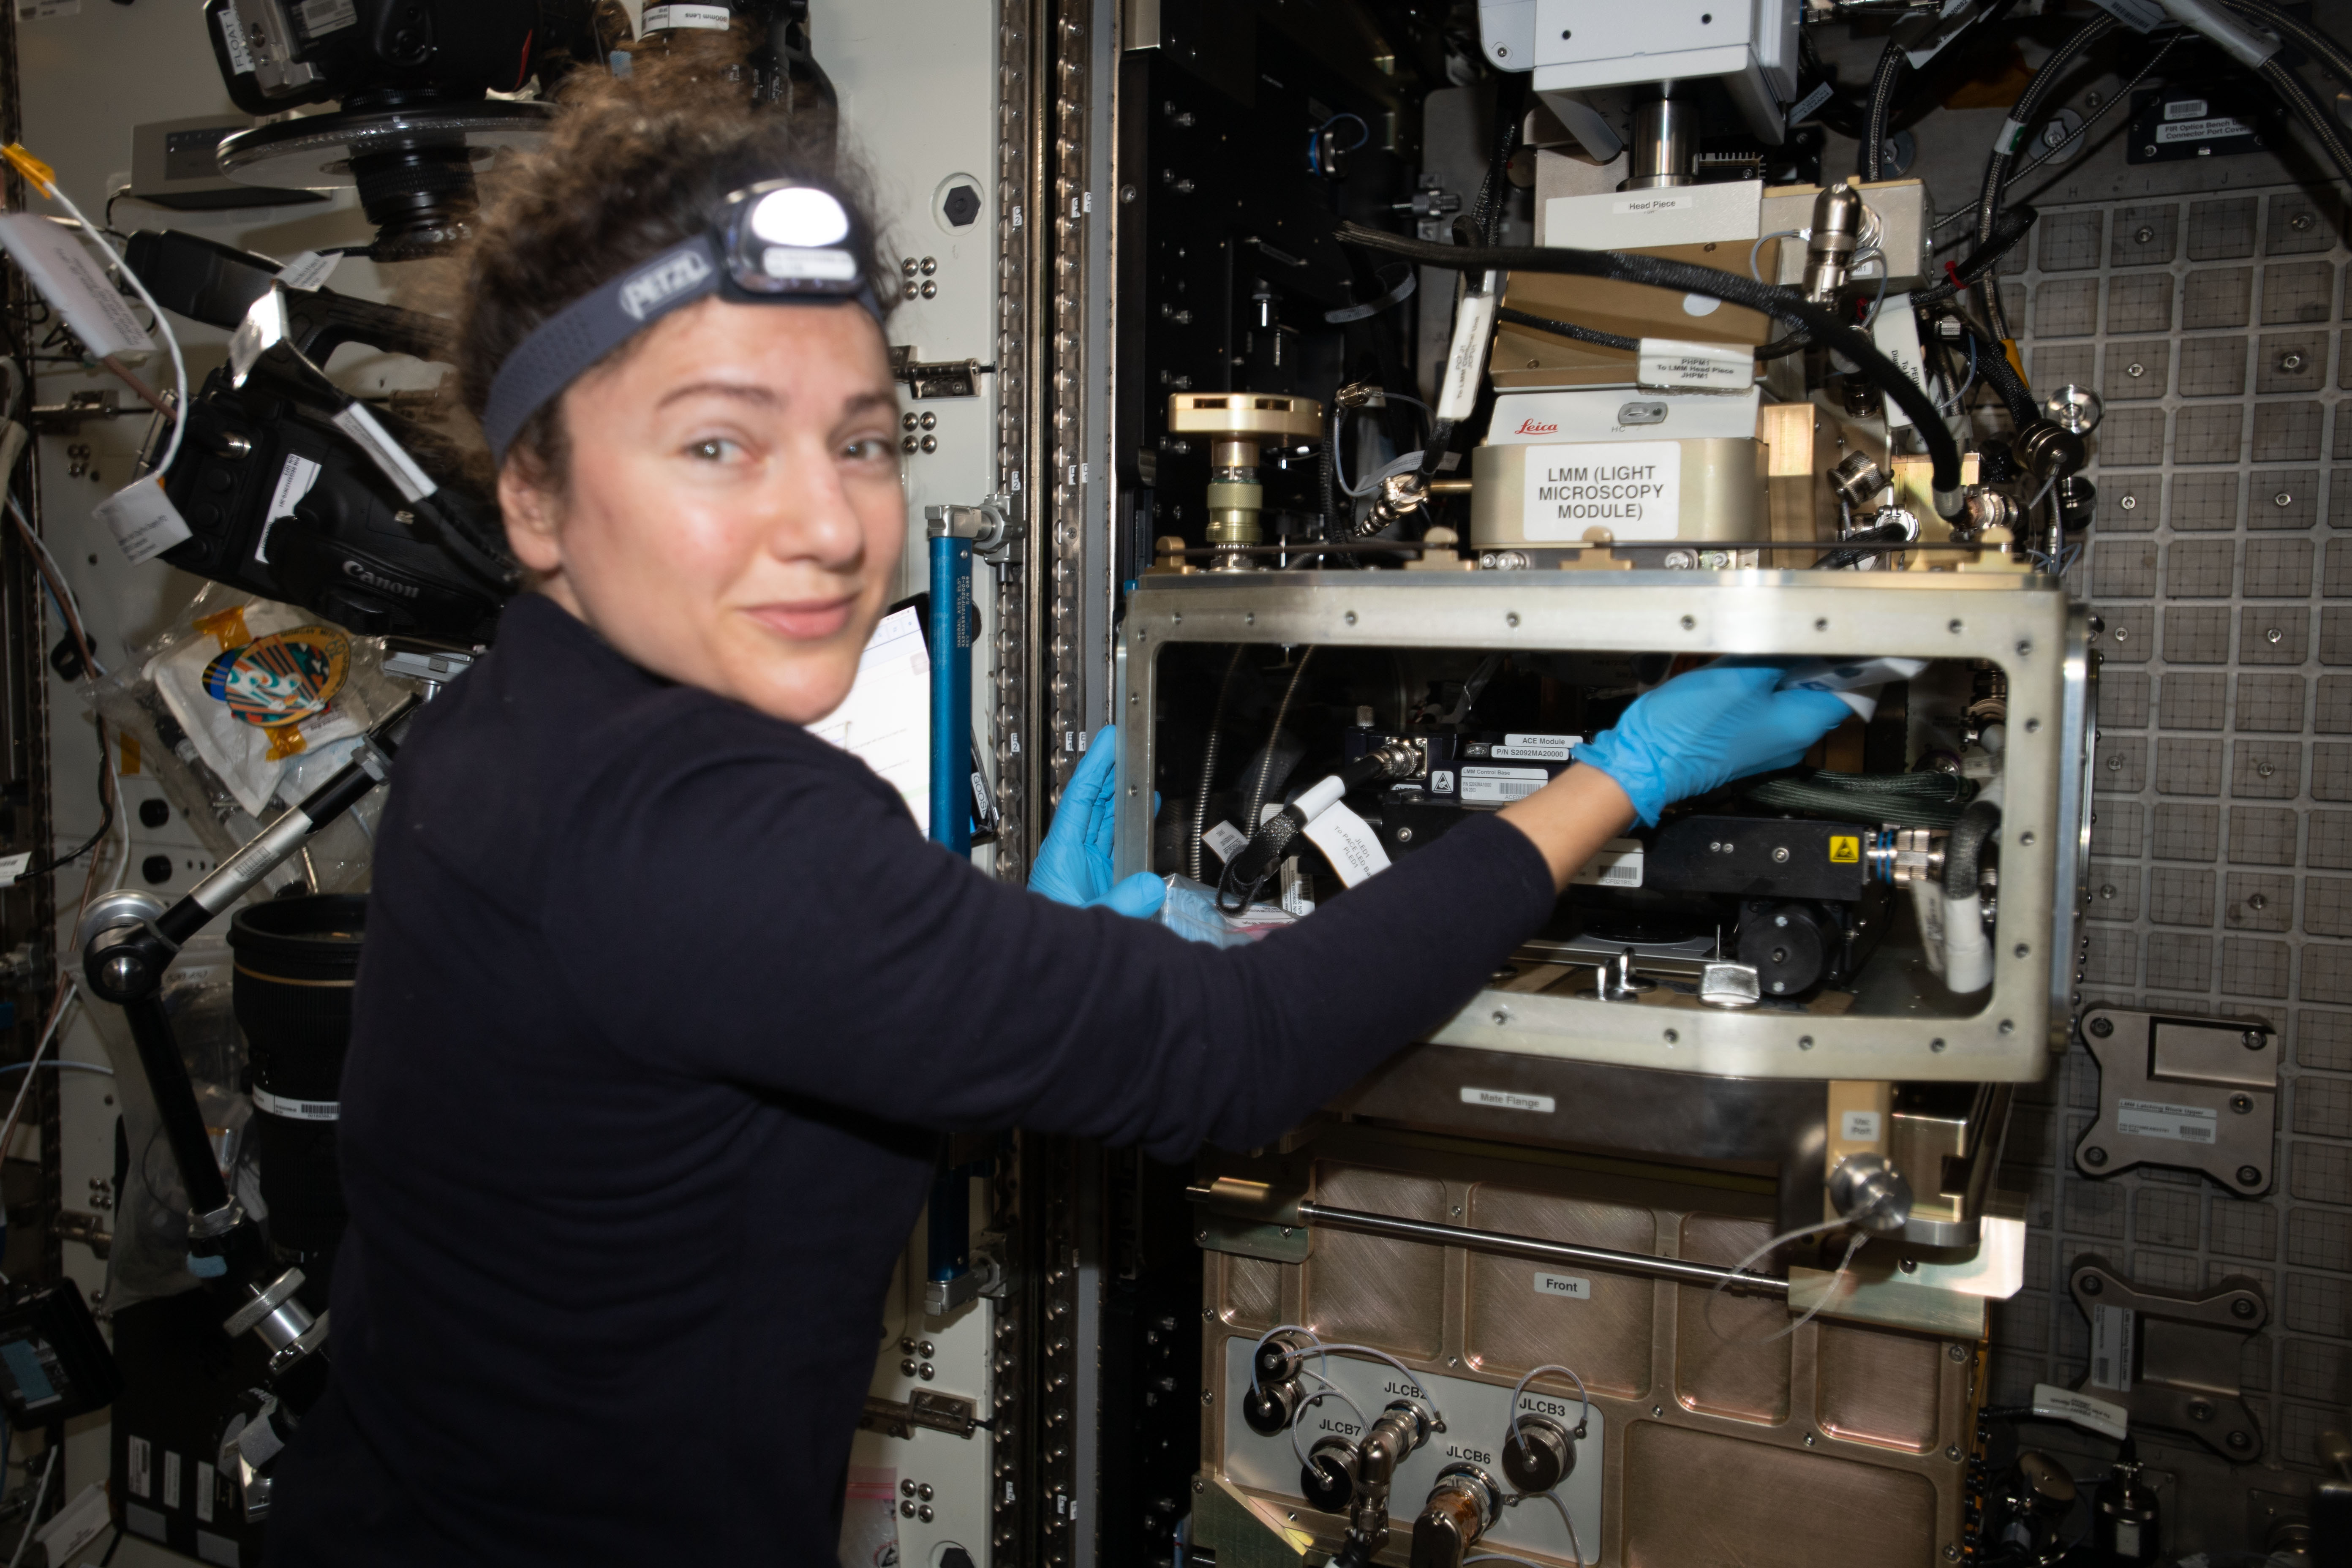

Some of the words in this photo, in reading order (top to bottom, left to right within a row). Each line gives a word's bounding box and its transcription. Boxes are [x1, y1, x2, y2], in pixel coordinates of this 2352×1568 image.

[226, 22, 244, 66] FLOAT
[2166, 130, 2204, 139] Connector
[1628, 201, 1651, 210] Head
[1652, 200, 1676, 209] Piece
[1514, 418, 1559, 435] Leica
[1548, 467, 1588, 482] LMM
[1594, 465, 1656, 485] (LIGHT
[1538, 484, 1664, 501] MICROSCOPY
[1557, 503, 1644, 521] MODULE)
[342, 560, 420, 598] Canon
[1510, 749, 1564, 757] S2092MA20000
[1334, 825, 1342, 834] To
[1342, 833, 1356, 852] PACE
[1355, 852, 1366, 866] LED
[1363, 866, 1372, 877] Ba
[1343, 846, 1359, 868] PLED1
[1355, 838, 1370, 858] JLED1
[1480, 1093, 1504, 1103] Mate
[1507, 1096, 1540, 1109] Flange
[1546, 1278, 1578, 1293] Front
[1519, 1397, 1566, 1417] JLCB3
[1319, 1418, 1361, 1437] JLCB7
[1446, 1445, 1492, 1465] JLCB6
